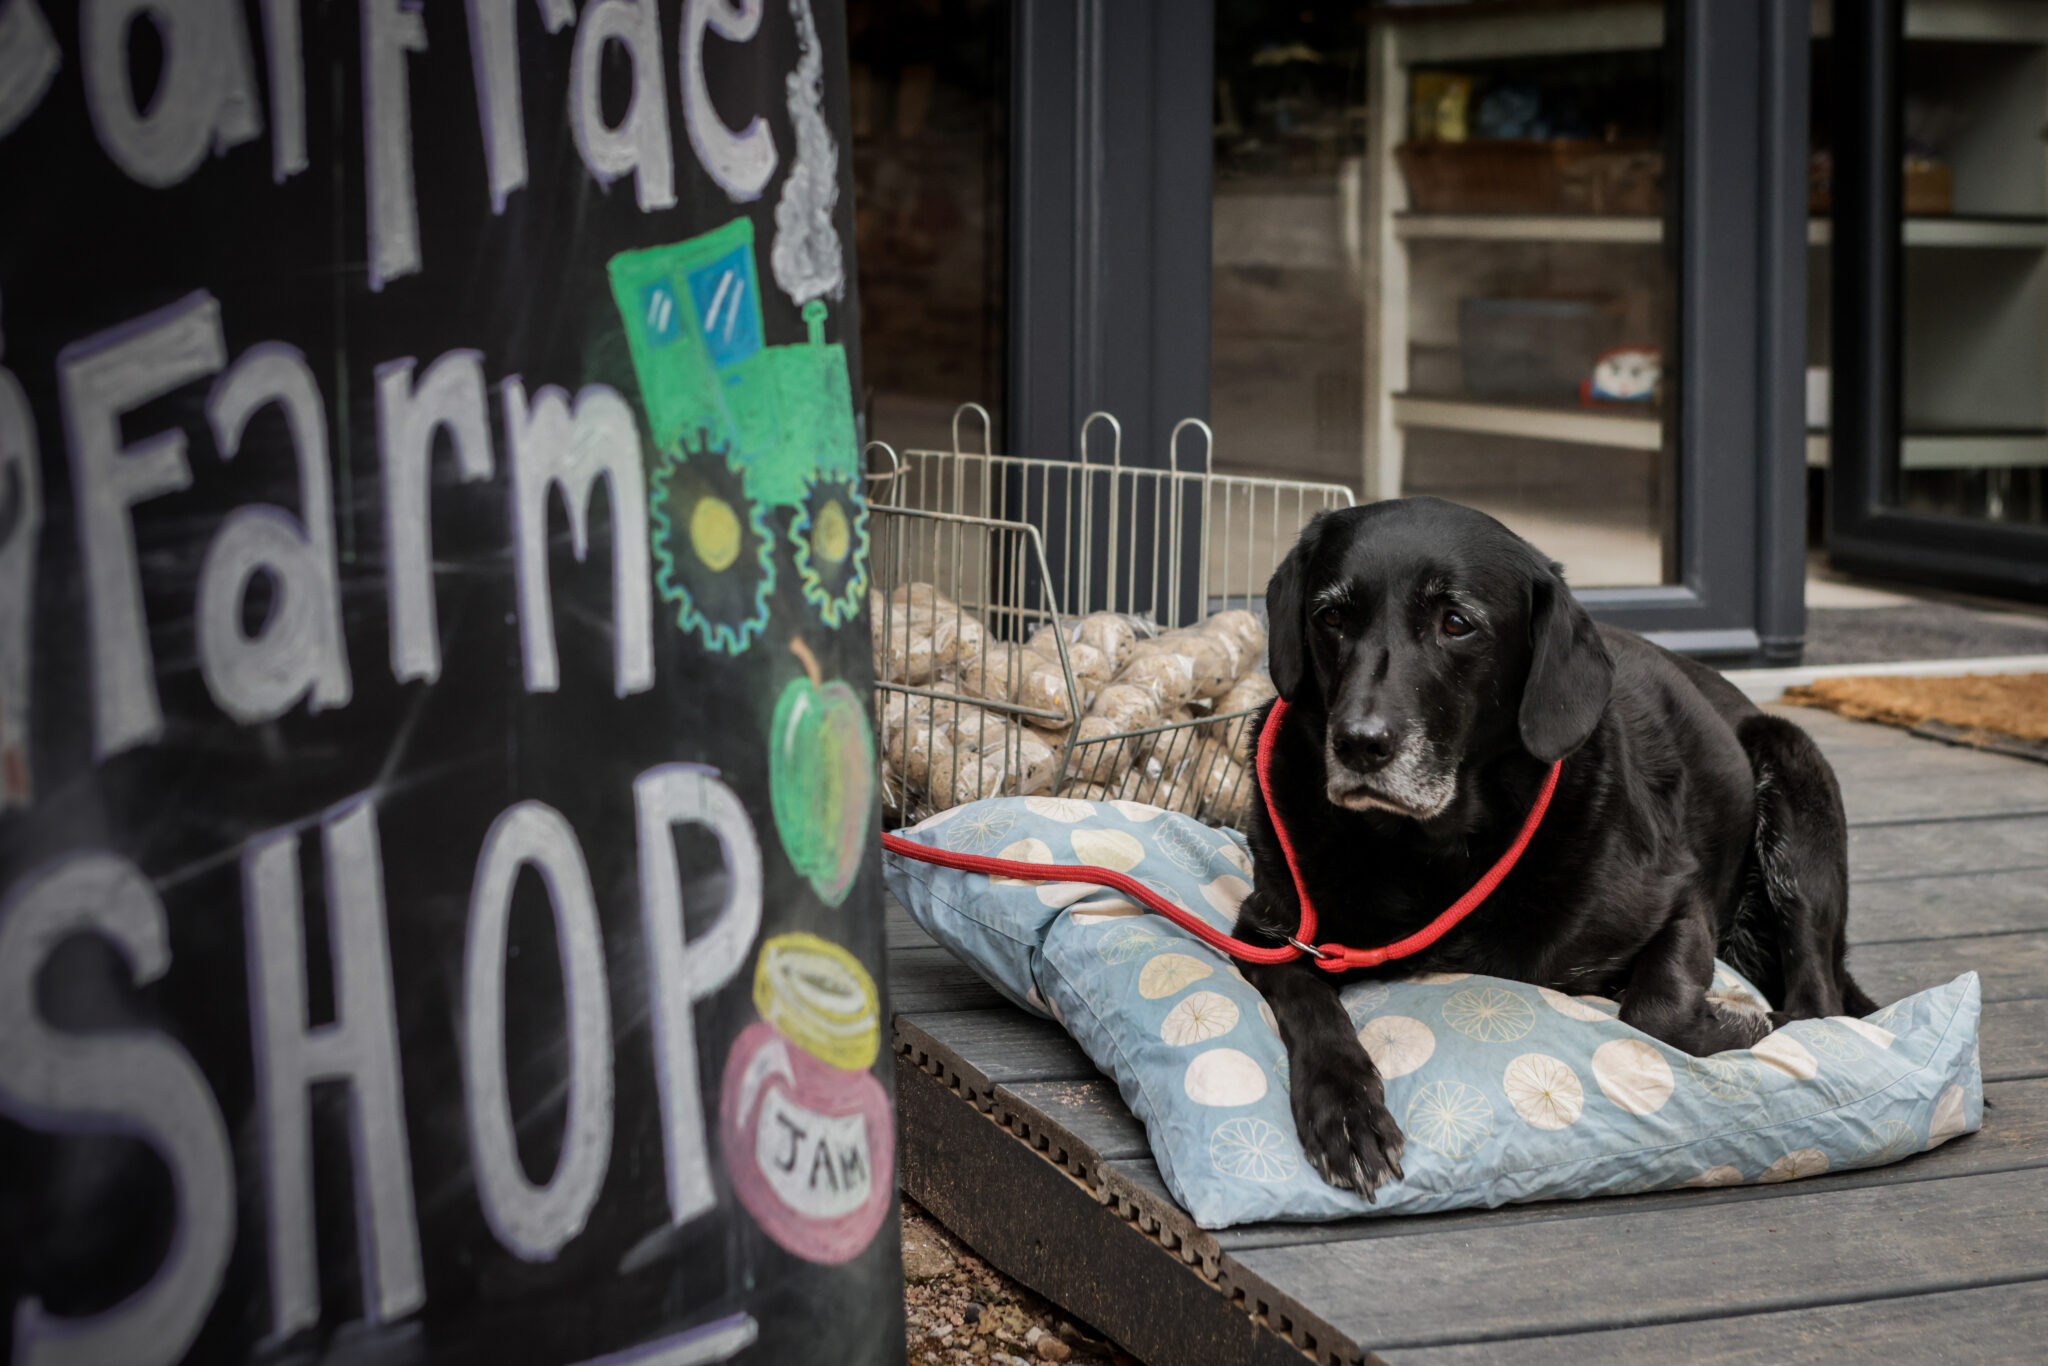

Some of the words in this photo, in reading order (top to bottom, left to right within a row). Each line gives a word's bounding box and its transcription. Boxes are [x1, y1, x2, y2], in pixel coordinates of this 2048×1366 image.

[57, 287, 656, 761] Farm
[0, 763, 764, 1366] SHOP
[773, 1111, 867, 1192] JAM
